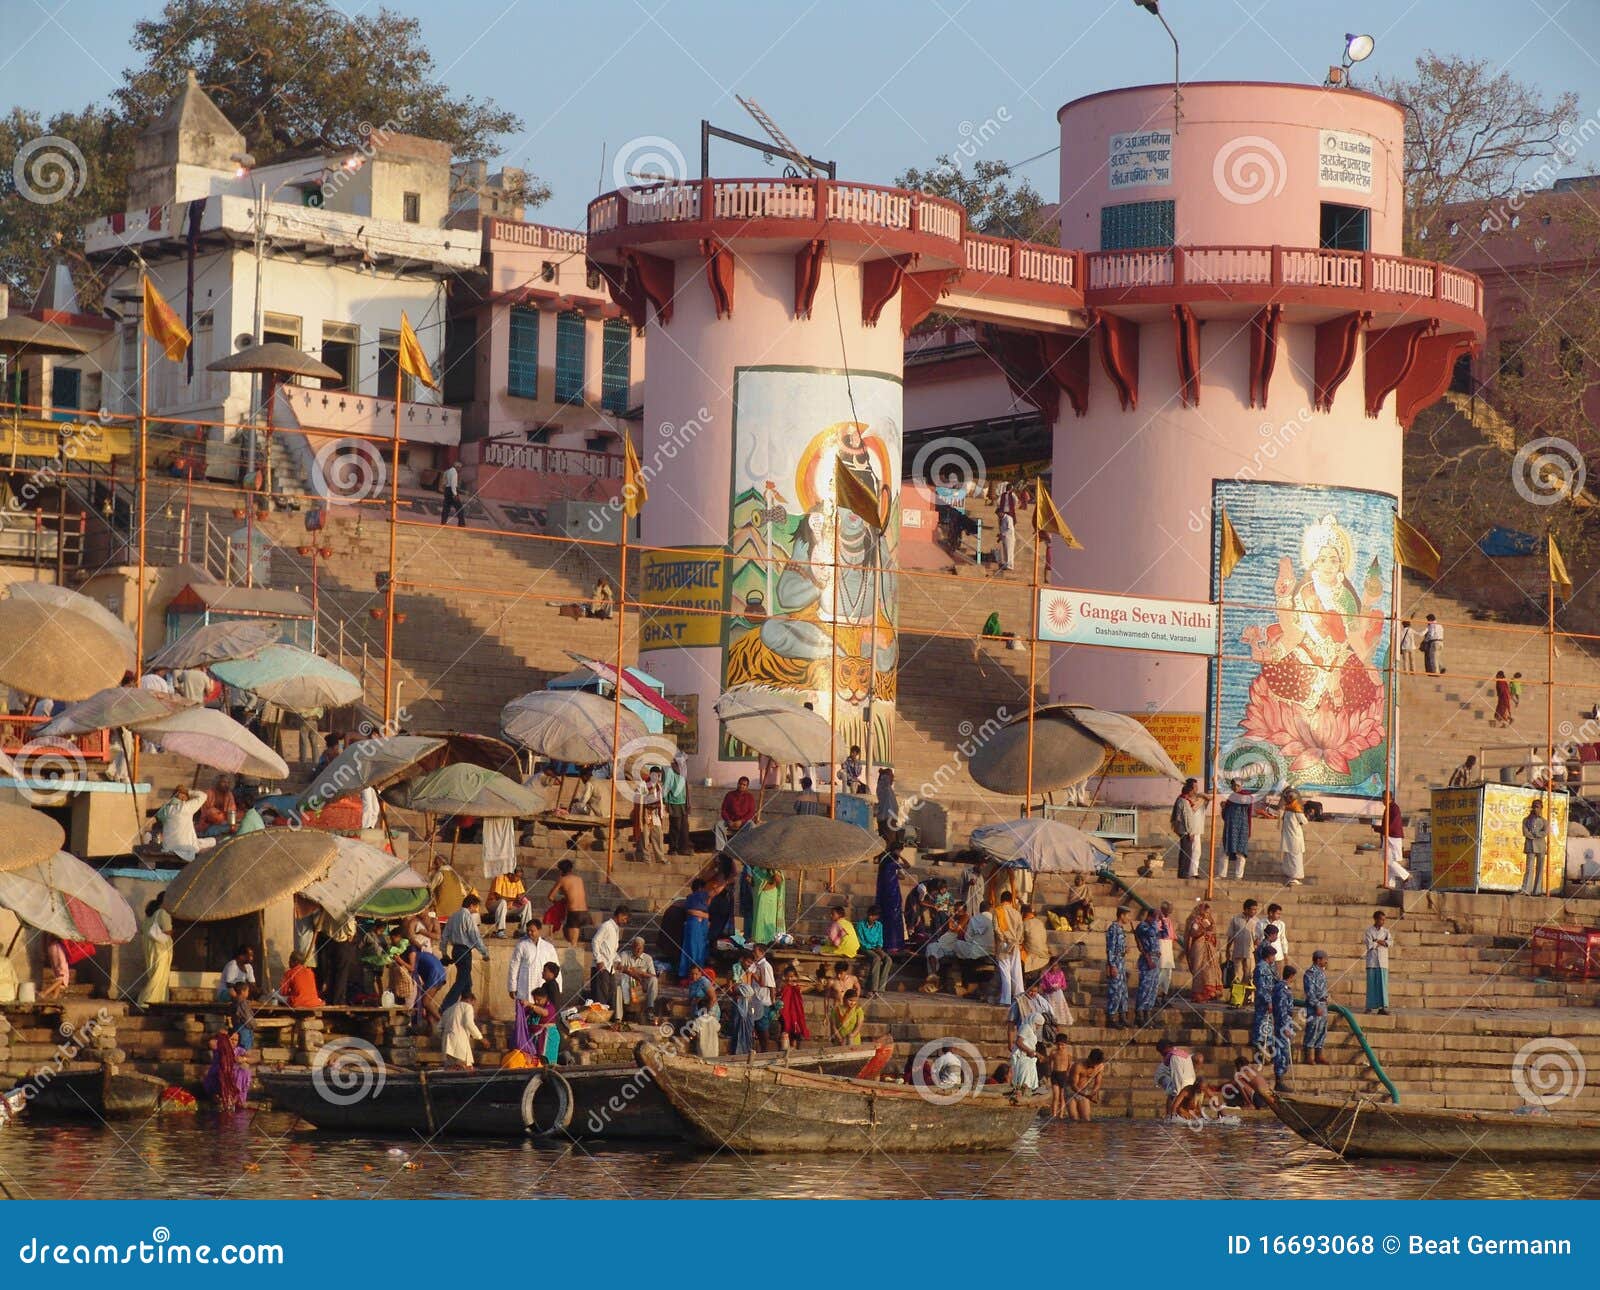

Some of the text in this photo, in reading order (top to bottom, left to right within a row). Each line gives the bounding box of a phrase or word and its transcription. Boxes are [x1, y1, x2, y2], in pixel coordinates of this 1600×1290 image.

[1079, 601, 1212, 629] Ganga Seva Nidhi
[643, 623, 687, 642] GHAT
[1095, 626, 1150, 639] Dashashwamedh
[1169, 633, 1197, 643] Varanasi
